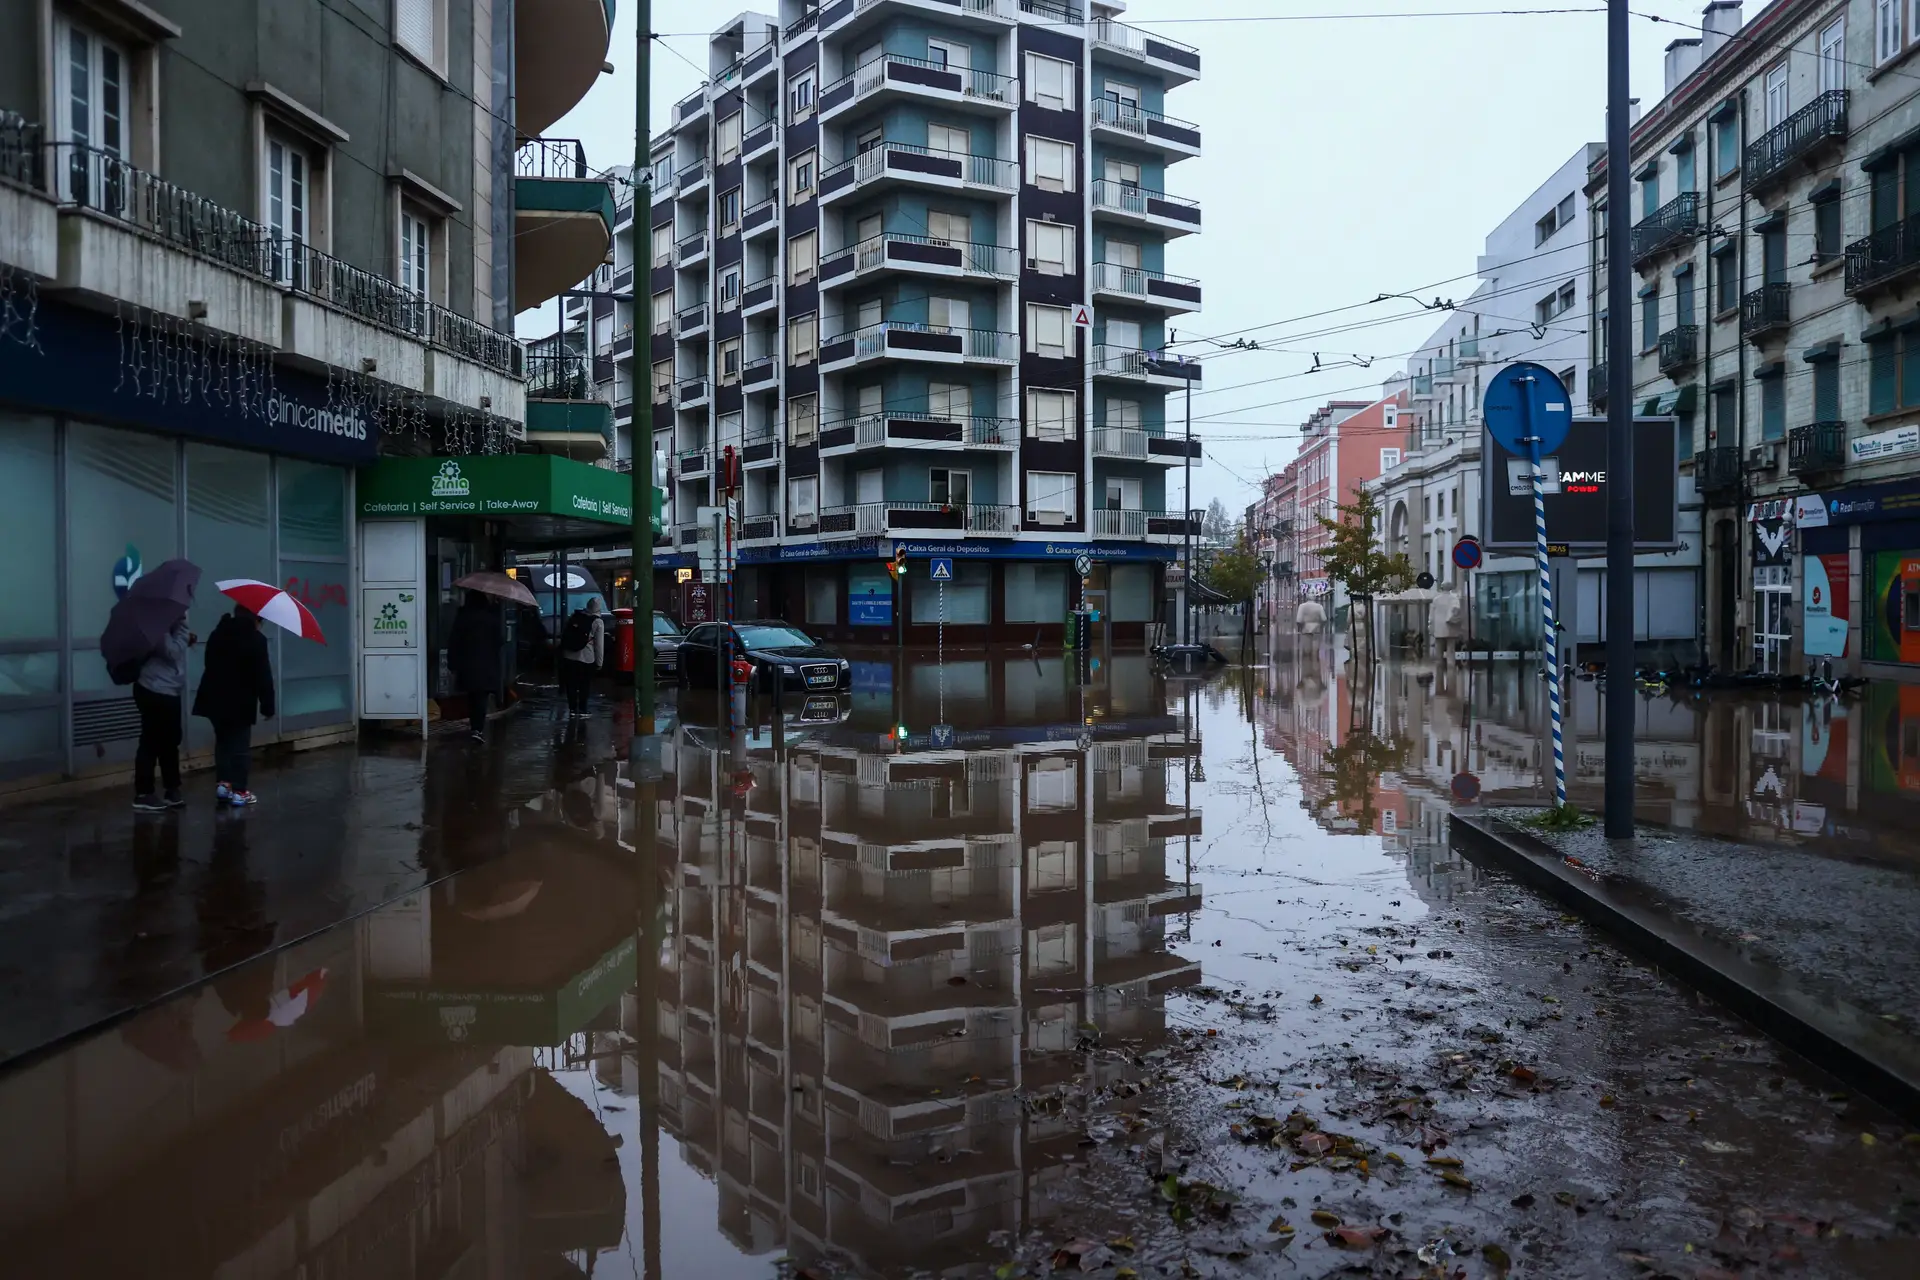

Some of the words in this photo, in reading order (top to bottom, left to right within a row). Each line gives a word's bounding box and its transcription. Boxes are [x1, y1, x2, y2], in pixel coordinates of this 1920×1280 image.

[1567, 485, 1599, 493] POWER
[364, 502, 409, 512] Cafetaria
[420, 501, 438, 511] Self
[440, 500, 475, 511] Service
[487, 499, 539, 510] Take-Away
[573, 494, 598, 512] Cafetaria
[602, 501, 612, 514] Self
[612, 502, 629, 518] Service
[908, 544, 927, 552] Caixa
[928, 544, 945, 553] Geral
[785, 550, 795, 558] Caixa
[795, 549, 805, 557] Geral
